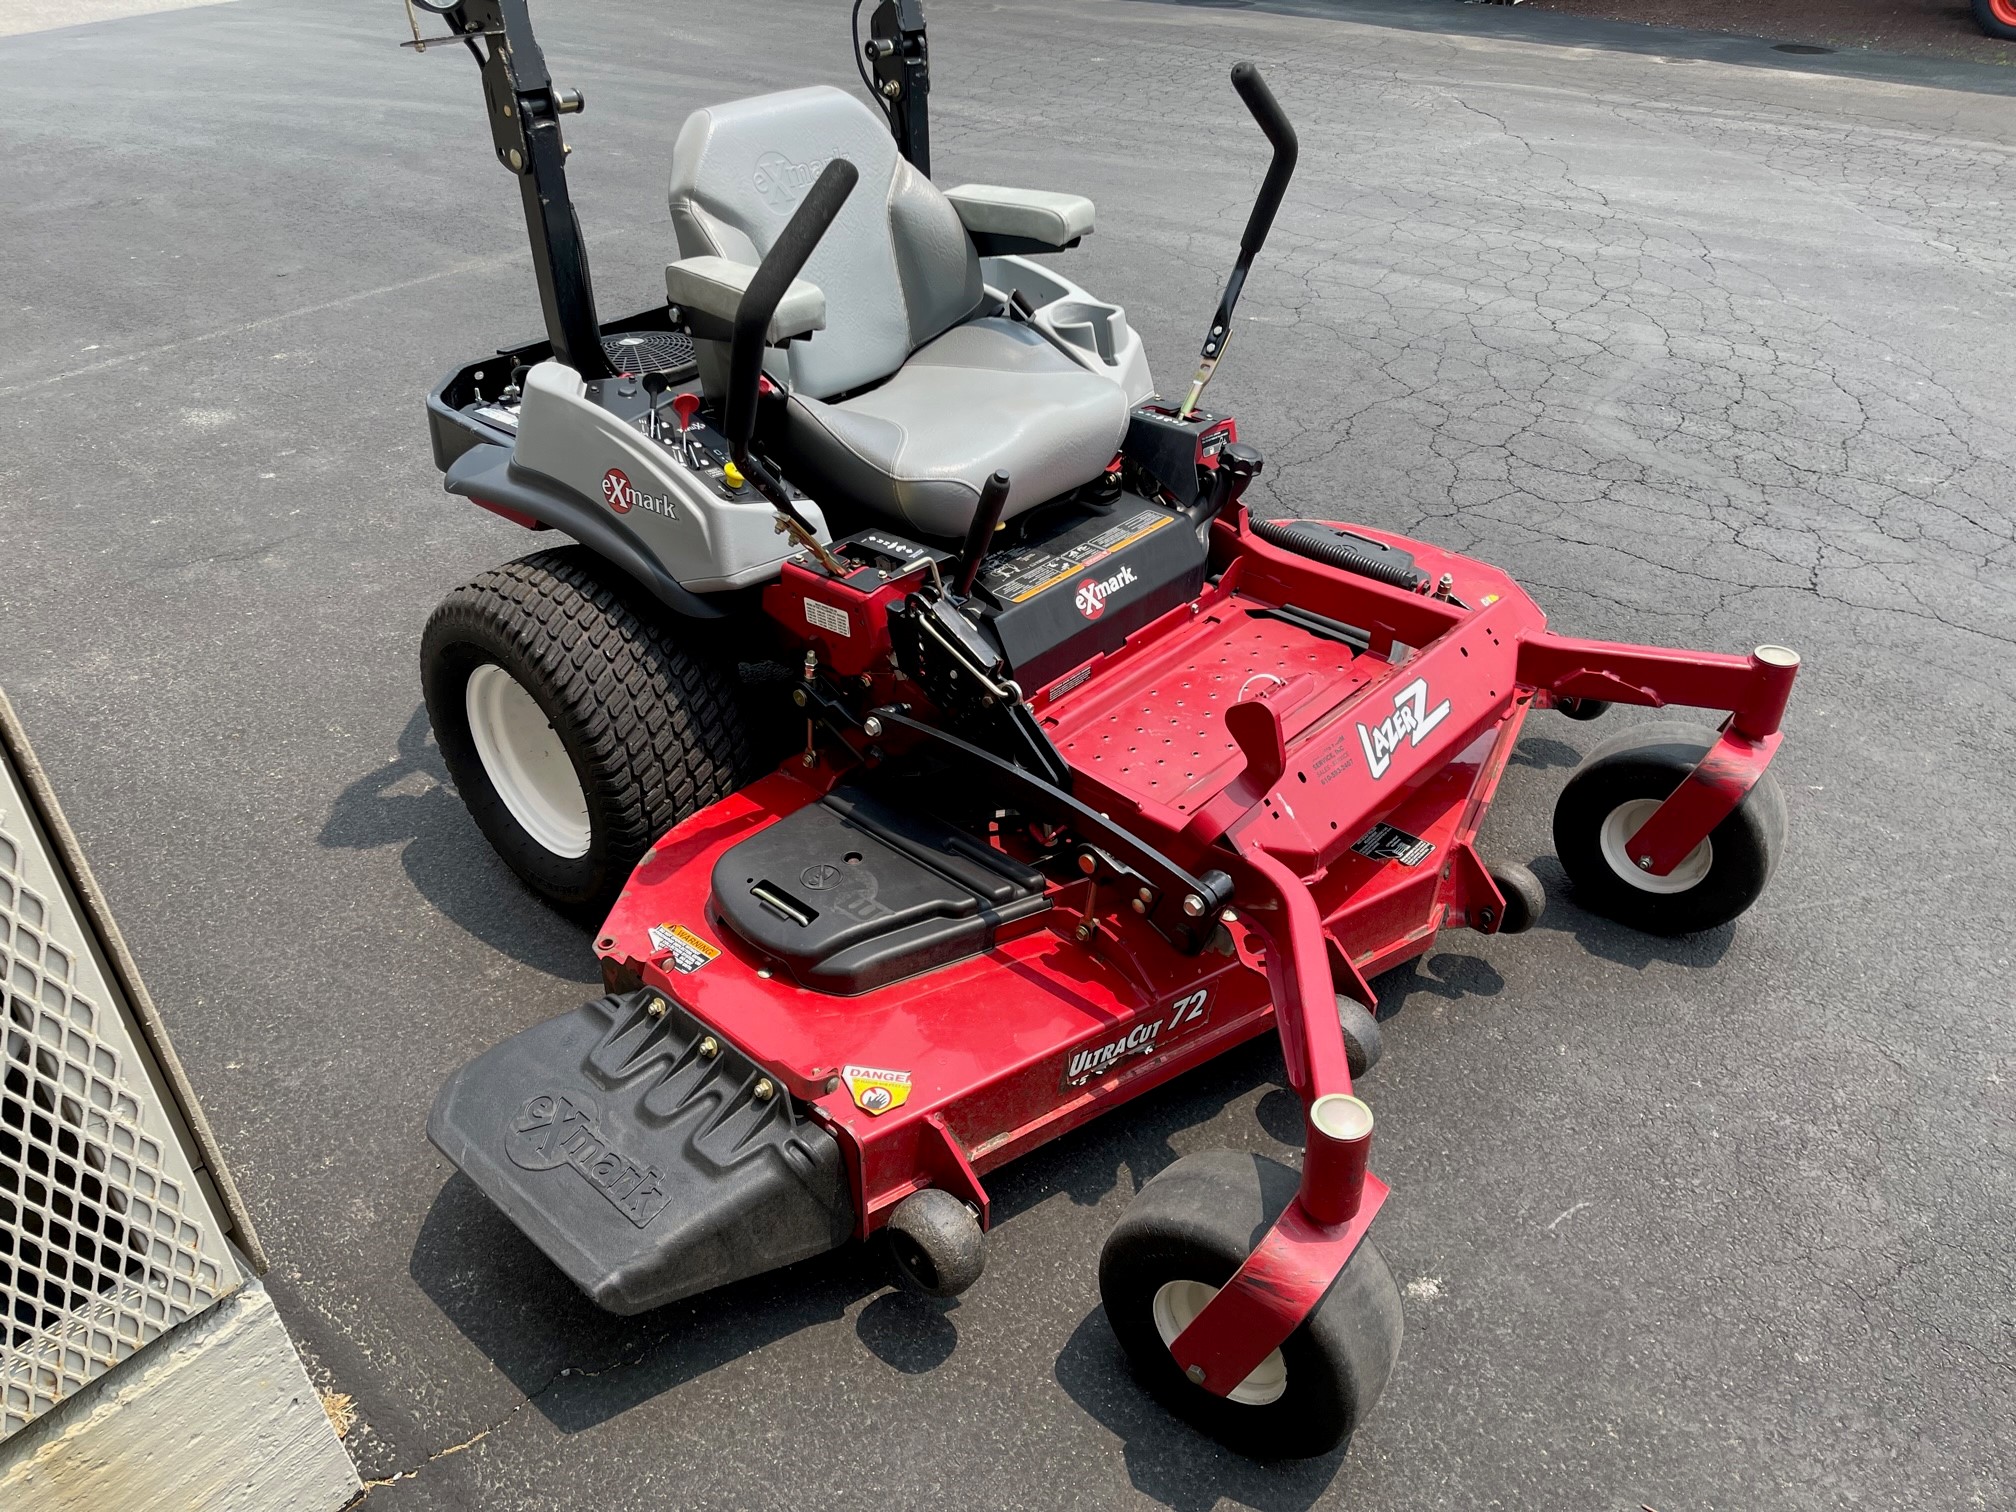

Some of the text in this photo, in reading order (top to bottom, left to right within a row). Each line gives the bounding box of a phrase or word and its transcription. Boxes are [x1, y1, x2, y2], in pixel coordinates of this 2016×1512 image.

[601, 474, 677, 520] eXmark
[1075, 565, 1138, 616] eXmark
[677, 929, 714, 956] WARNING
[1168, 989, 1208, 1031] 72
